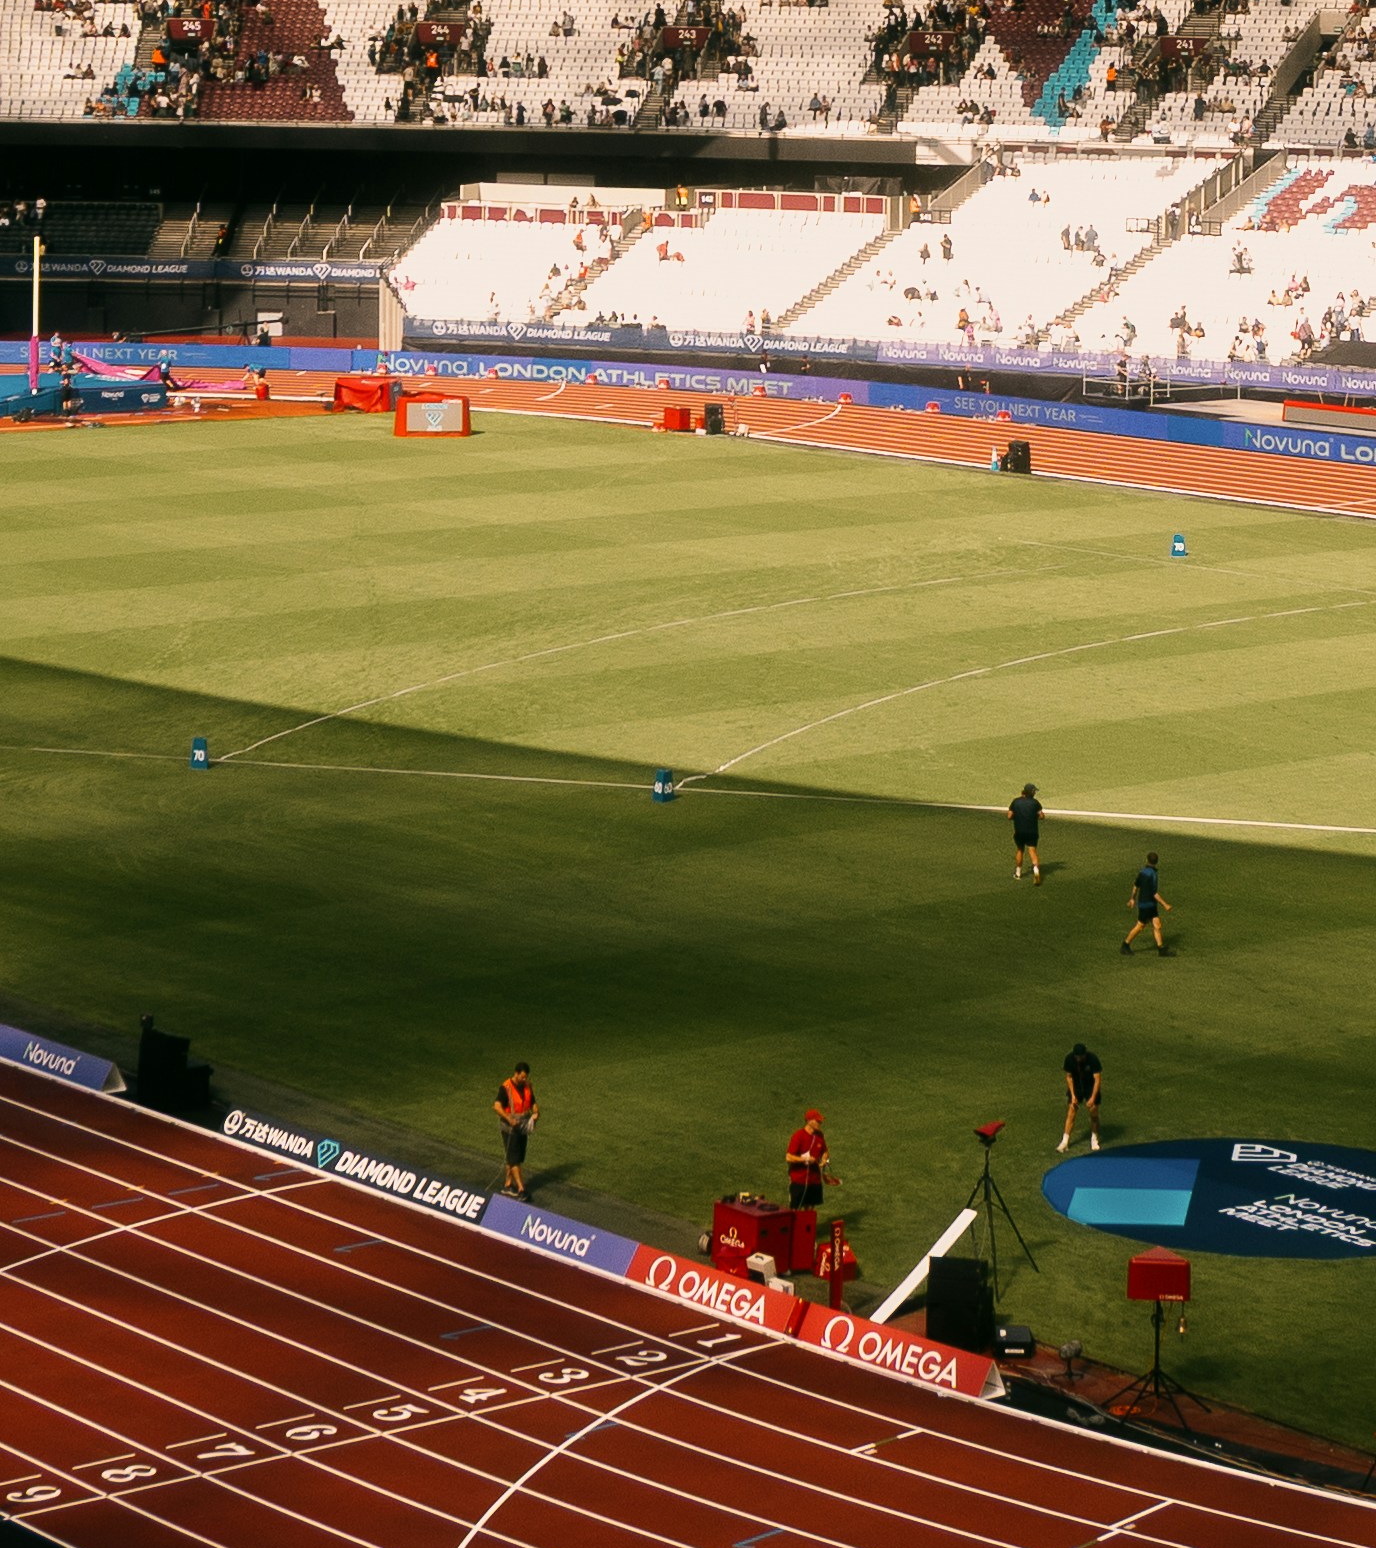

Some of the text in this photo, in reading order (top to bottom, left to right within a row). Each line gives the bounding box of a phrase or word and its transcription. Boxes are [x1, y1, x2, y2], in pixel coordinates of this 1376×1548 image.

[182, 21, 201, 30] 245
[431, 25, 449, 34] 244
[679, 30, 696, 39] 243
[924, 35, 943, 44] 242
[1176, 40, 1193, 49] 241
[107, 264, 150, 274] DIAMOND
[152, 264, 188, 274] LEAGUE
[276, 266, 313, 277] WANDA
[332, 268, 375, 279] DIAMOND
[470, 325, 612, 342] WANDA DIAMOND LEAGUE
[92, 347, 134, 360] NEXT
[706, 337, 849, 354] WANDA DIAMOND LEAGUE
[882, 347, 927, 360] Novuna
[939, 348, 984, 363] Novuna
[995, 353, 1041, 368] Novuna
[479, 362, 586, 381] LONDON
[1224, 367, 1270, 382] Novuna
[1282, 372, 1328, 387] Novuna
[954, 397, 1076, 423] SEE YOU NEXT YEAR
[1244, 428, 1330, 456] Novuna
[194, 750, 205, 761] 70
[654, 783, 663, 794] 60
[24, 1041, 78, 1076] Novuna
[267, 1127, 314, 1159] WANDA
[335, 1150, 417, 1195] DIAMOND
[413, 1176, 486, 1220] LEAGUE
[1267, 1166, 1350, 1189] LEAGUE
[1219, 1207, 1299, 1231] MEET
[1253, 1200, 1366, 1235] LONDON
[521, 1214, 590, 1257] Novuna
[720, 1234, 745, 1249] OMEGA
[678, 1270, 766, 1325] OMEGA
[697, 1334, 742, 1348] 1
[615, 1350, 668, 1367] 2
[858, 1333, 958, 1389] OMEGA
[538, 1367, 590, 1385] 3
[459, 1386, 507, 1404] 4
[373, 1403, 429, 1423] 5
[285, 1423, 338, 1442] 6
[197, 1442, 255, 1459] 7
[101, 1464, 157, 1483] 8
[6, 1485, 62, 1504] 9
